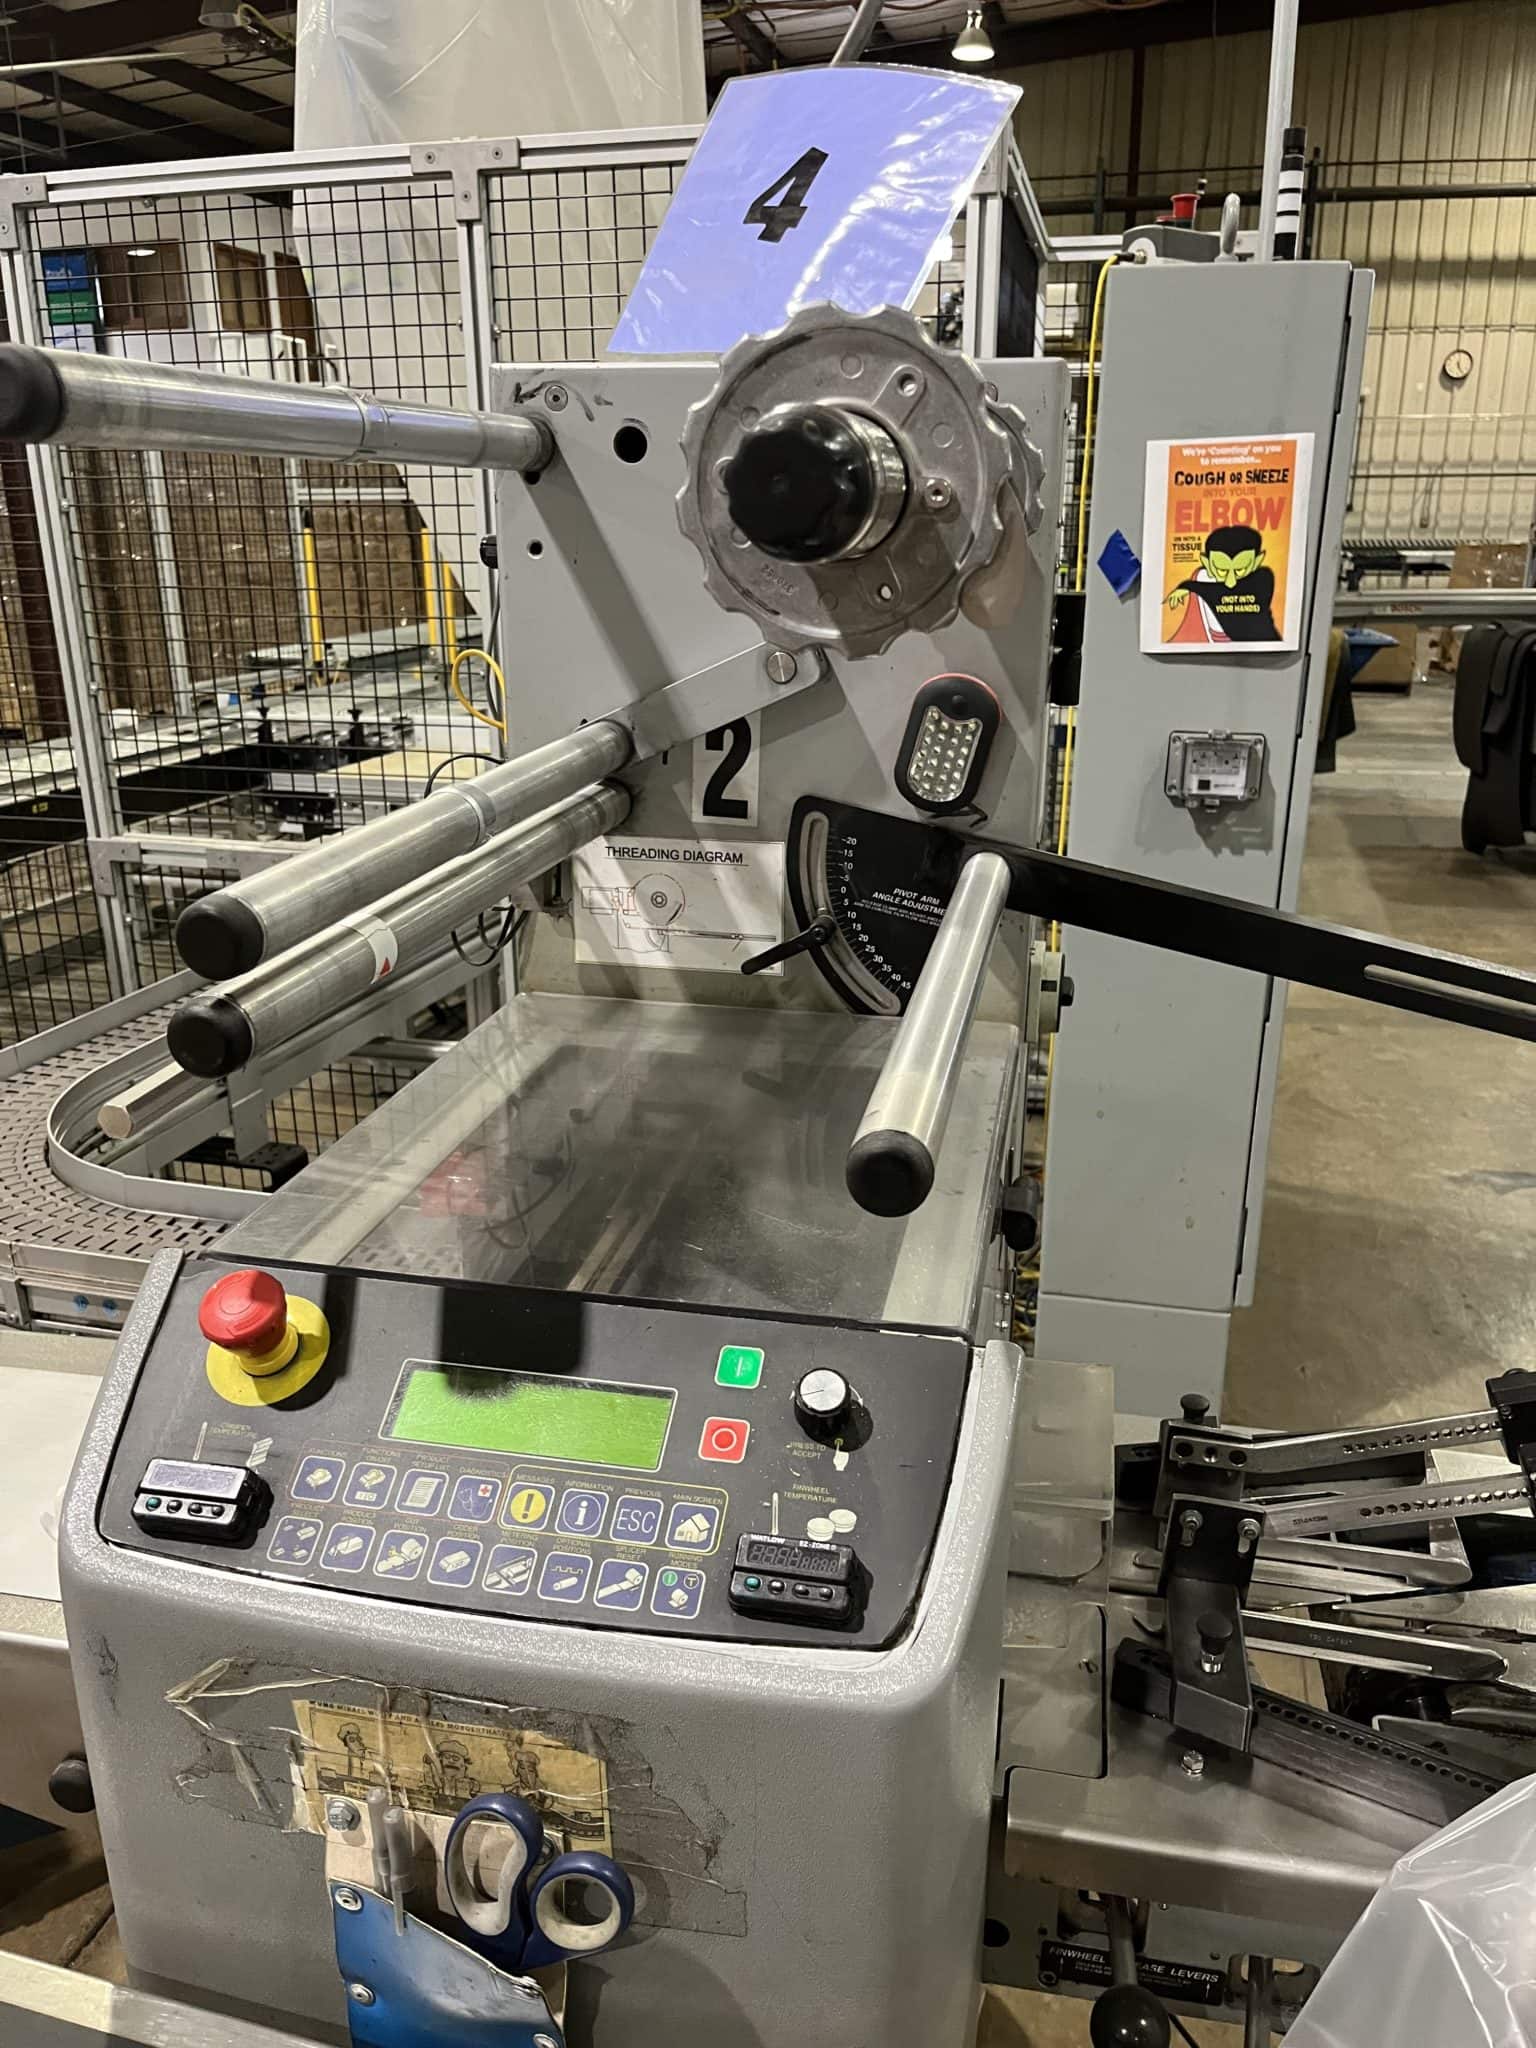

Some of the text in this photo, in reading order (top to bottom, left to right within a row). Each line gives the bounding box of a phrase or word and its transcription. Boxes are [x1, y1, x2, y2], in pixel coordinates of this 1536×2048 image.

[743, 147, 829, 243] 4
[1174, 470, 1226, 486] COUGH
[1245, 468, 1289, 484] SNEEZE
[1202, 486, 1257, 497] INTO YOUR
[1174, 496, 1287, 533] ELBOW
[1172, 543, 1202, 551] TISSUE
[703, 717, 751, 819] 2
[605, 846, 743, 863] THREADING DIAGRAM
[840, 886, 847, 894] 0
[872, 891, 901, 904] ANGLE
[893, 887, 940, 906] PIVOT ARM
[843, 898, 849, 906] 5
[847, 911, 857, 919] 10
[852, 922, 862, 931] 15
[858, 934, 869, 943] 20
[865, 944, 876, 953] 25
[872, 954, 884, 963] 30
[881, 963, 892, 973] 35
[890, 972, 901, 982] 40
[900, 980, 912, 990] 45
[616, 1508, 656, 1534] ESC
[750, 1534, 786, 1545] WATLOW
[1171, 1967, 1220, 1984] LEVERS
